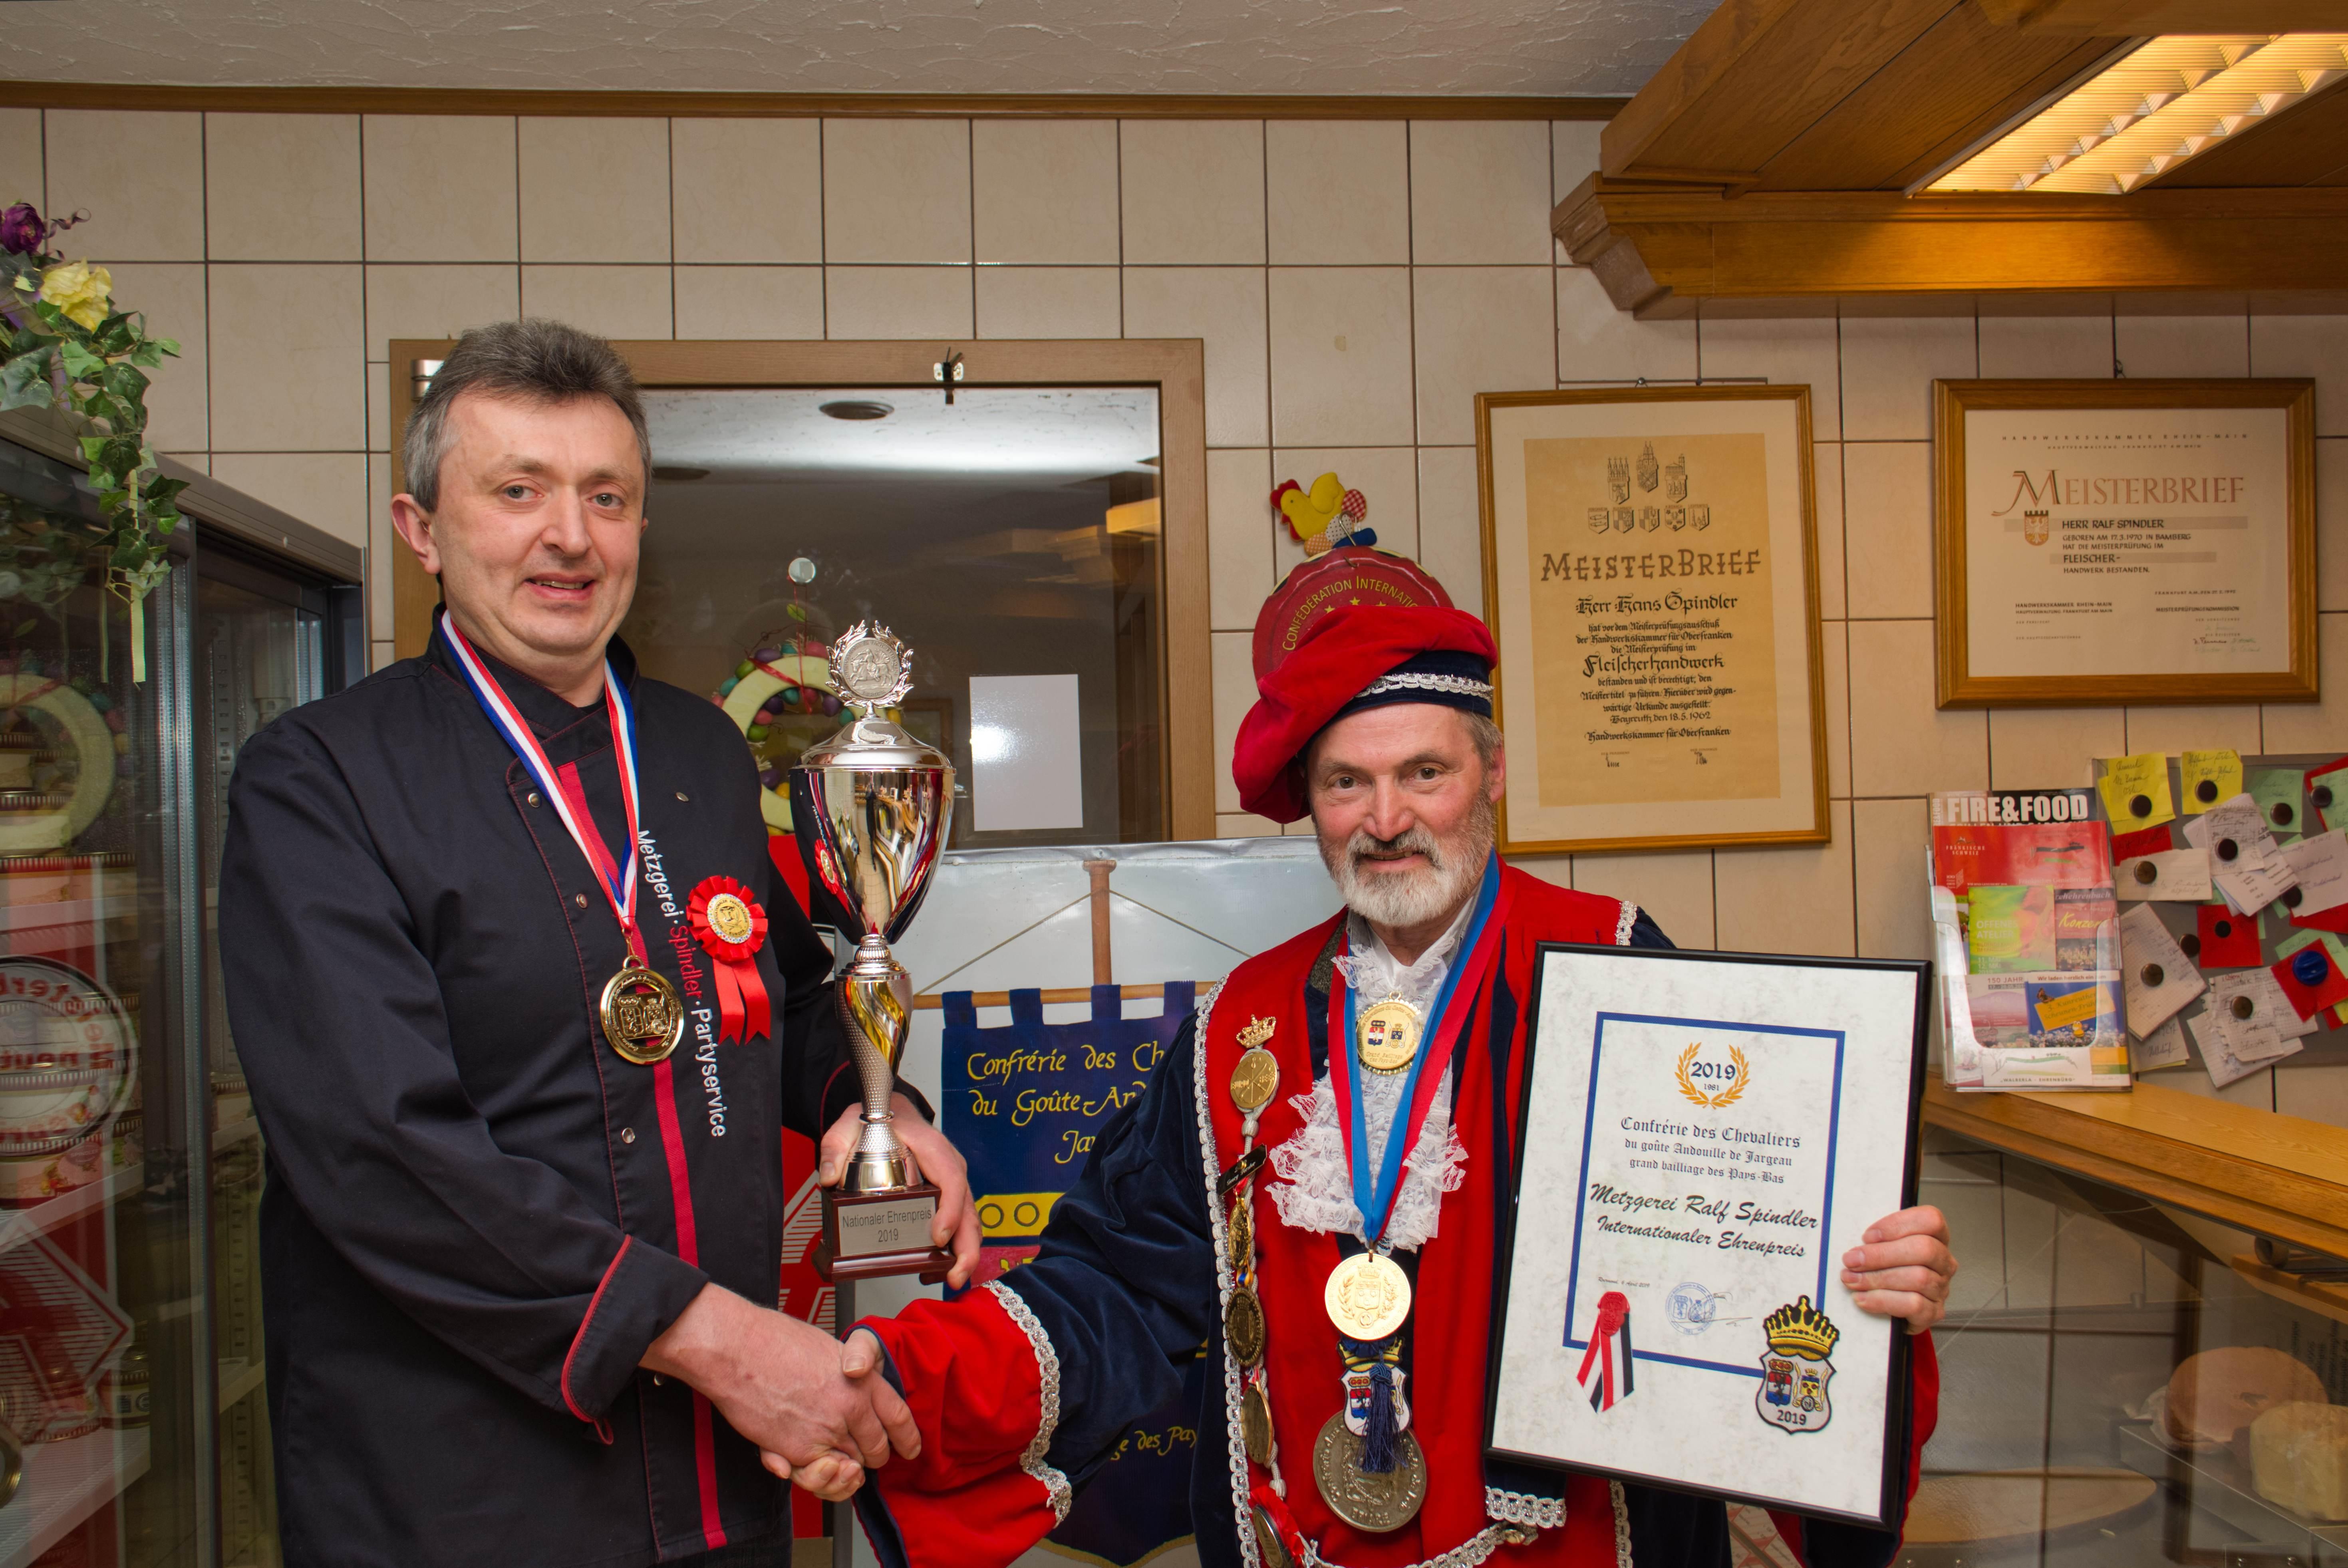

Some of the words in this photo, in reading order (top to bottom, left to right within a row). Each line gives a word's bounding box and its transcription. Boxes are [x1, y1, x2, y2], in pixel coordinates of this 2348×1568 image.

[1991, 469, 2243, 516] MEISTERBRIEF
[2062, 520, 2088, 529] HERR
[2092, 520, 2115, 528] RALF
[2117, 519, 2164, 528] SPINDLER
[1541, 549, 1761, 582] MEISTERBRIEF
[2064, 554, 2121, 563] FLEISCHER-
[1575, 595, 1611, 620] Herr
[1615, 593, 1662, 617] Hans
[1665, 588, 1738, 619] Spindler
[1282, 579, 1353, 651] CONFÉDÉRATION
[1615, 622, 1628, 631] dem
[1575, 634, 1589, 644] der
[1589, 633, 1667, 646] Handwerkskammer
[1681, 629, 1733, 642] Oberfranken
[1611, 644, 1622, 654] die
[1685, 642, 1696, 652] im
[1583, 652, 1725, 678] Fleischerhandwerk
[1598, 677, 1634, 687] bestanden
[1634, 675, 1647, 685] und
[1698, 673, 1712, 683] den
[1696, 685, 1713, 695] wird
[1603, 703, 1632, 713] wärtige
[1633, 701, 1669, 712] Urkunde
[1653, 713, 1667, 721] den
[1584, 727, 1665, 744] Handwerkskammer
[1666, 726, 1678, 742] für
[1678, 725, 1732, 740] Oberfranken
[1947, 794, 2089, 823] FIRE&FOOD
[1976, 920, 2018, 929] OFFENES
[1977, 930, 2014, 939] ATELIER
[638, 829, 684, 918] Metzgerei
[668, 925, 703, 999] Spindler
[691, 1007, 727, 1138] Partyservice
[967, 1048, 1067, 1086] Confrérie
[1081, 1044, 1116, 1071] des
[1690, 1061, 1736, 1080] 2019
[968, 1090, 999, 1115] du
[1621, 1116, 1688, 1136] Confrérie
[1692, 1124, 1717, 1139] des
[1721, 1126, 1801, 1149] Chevaliers
[1625, 1138, 1637, 1149] du
[1641, 1139, 1670, 1153] goûte
[1673, 1142, 1726, 1159] Andouille
[1729, 1149, 1742, 1161] de
[1744, 1150, 1793, 1166] Jargeau
[1629, 1158, 1659, 1170] grand
[1661, 1160, 1705, 1176] bailliage
[1707, 1165, 1725, 1177] des
[1590, 1183, 1679, 1213] Metzgerei
[1684, 1195, 1731, 1224] Ralf
[1734, 1201, 1819, 1230] Spindler
[842, 1213, 885, 1228] Nationaler
[887, 1207, 932, 1224] Ehrenpreis
[878, 1228, 899, 1242] 2019
[1597, 1215, 1712, 1245] Internationaler
[1717, 1231, 1806, 1258] Ehrenpreis
[1776, 1409, 1807, 1425] 2019
[1134, 1430, 1161, 1449] des
